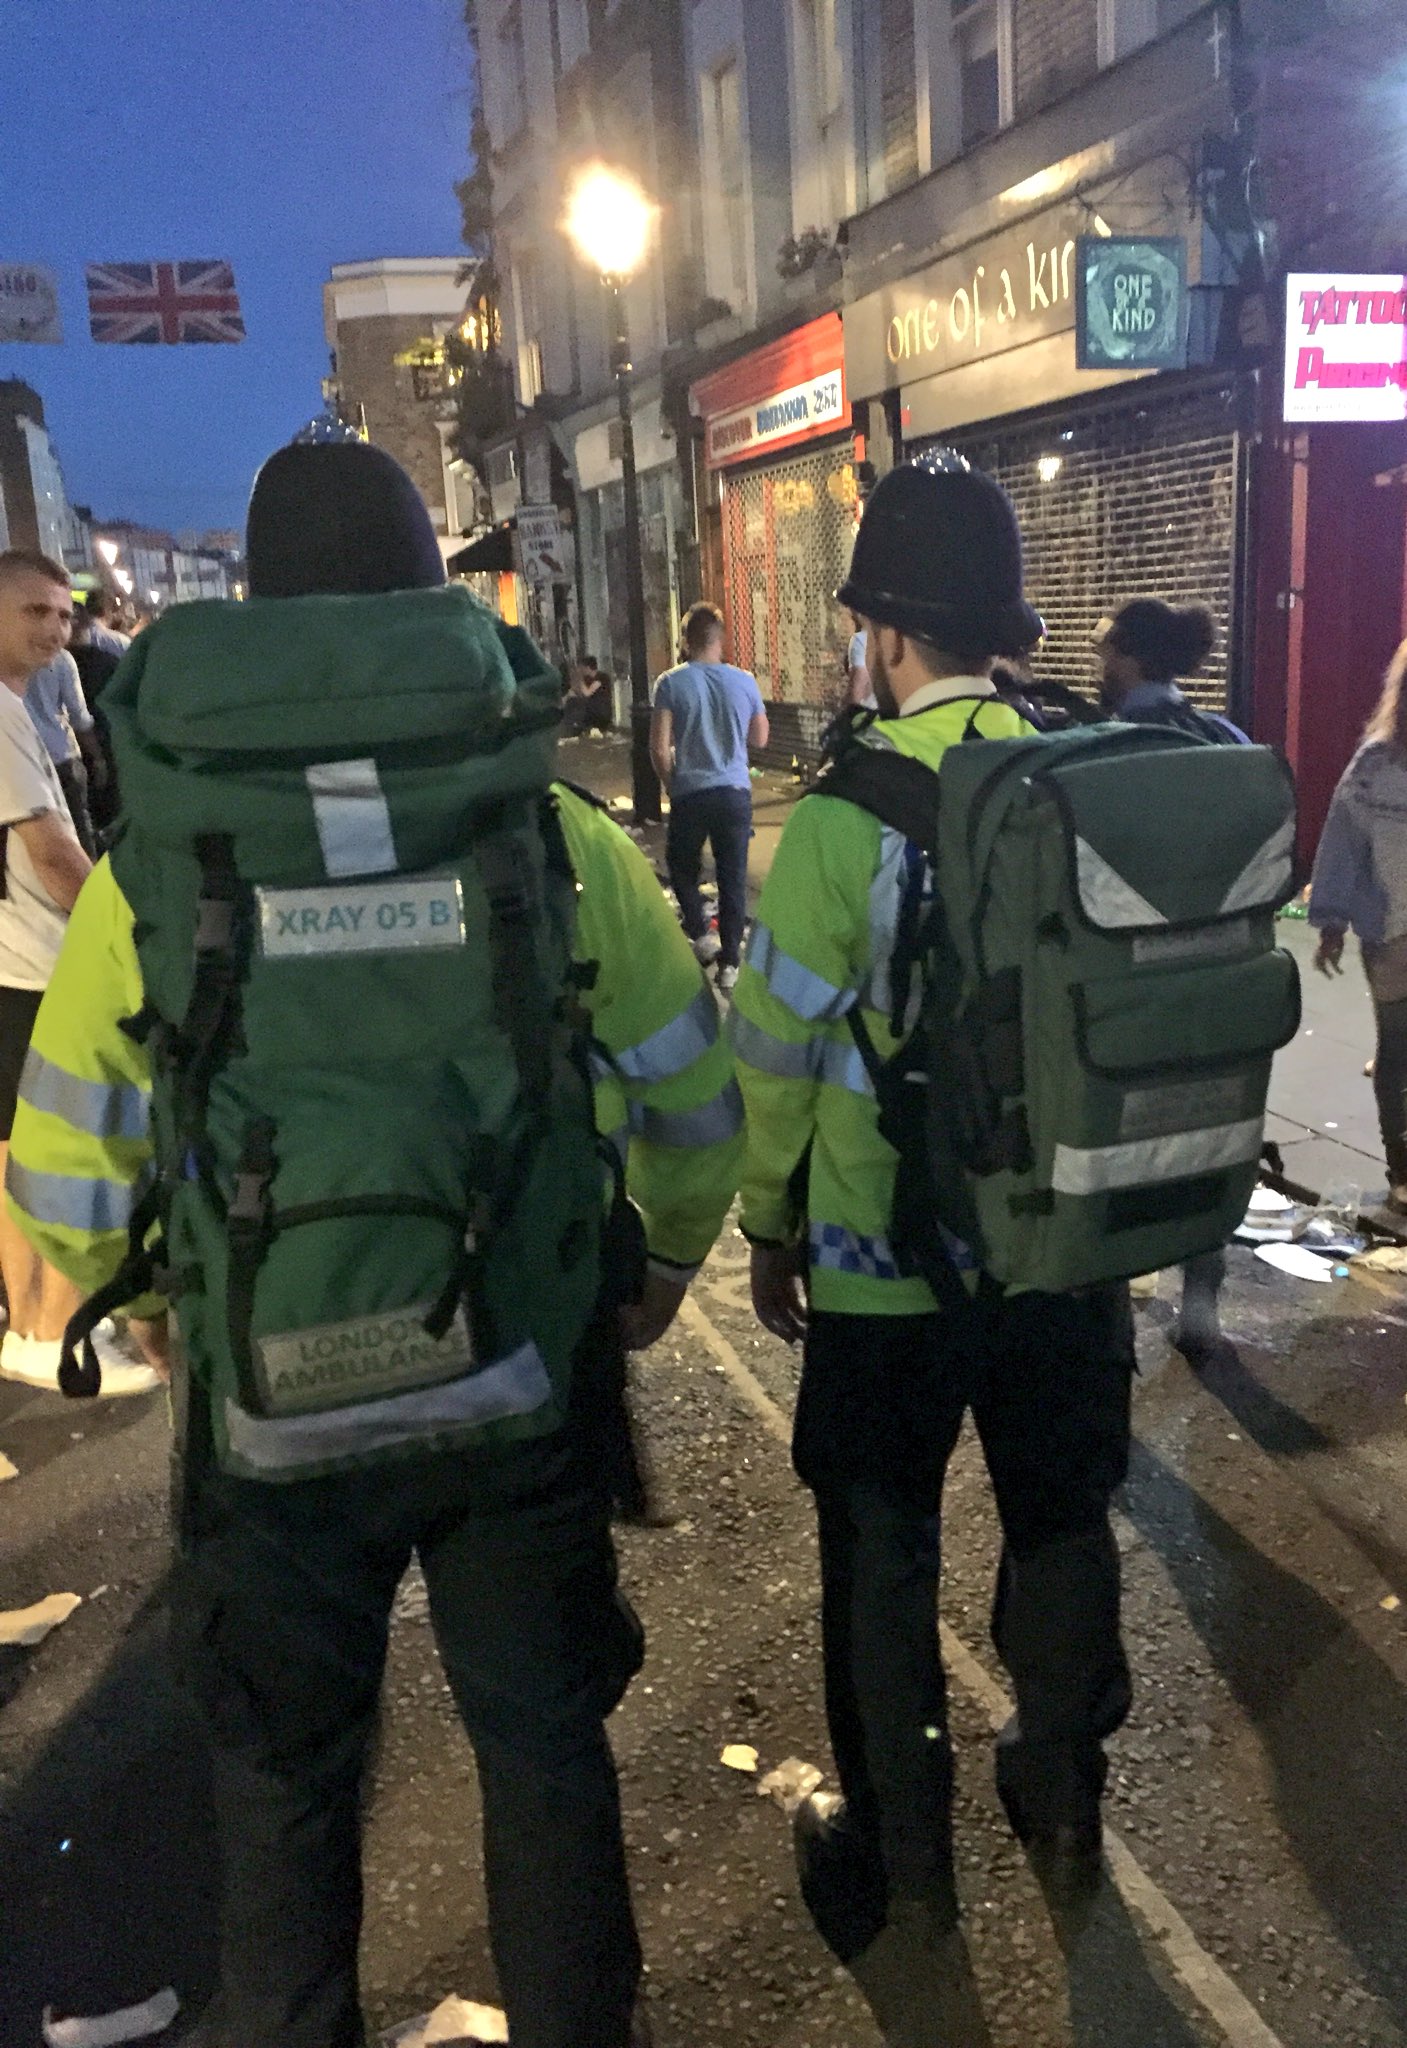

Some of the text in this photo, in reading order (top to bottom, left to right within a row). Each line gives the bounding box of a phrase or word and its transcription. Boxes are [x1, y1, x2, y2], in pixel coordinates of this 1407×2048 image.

[1113, 273, 1153, 298] ONE
[888, 299, 940, 363] one
[950, 265, 985, 347] of
[996, 268, 1017, 324] a
[1111, 307, 1156, 332] KIND
[276, 899, 451, 937] XRAY 05 B
